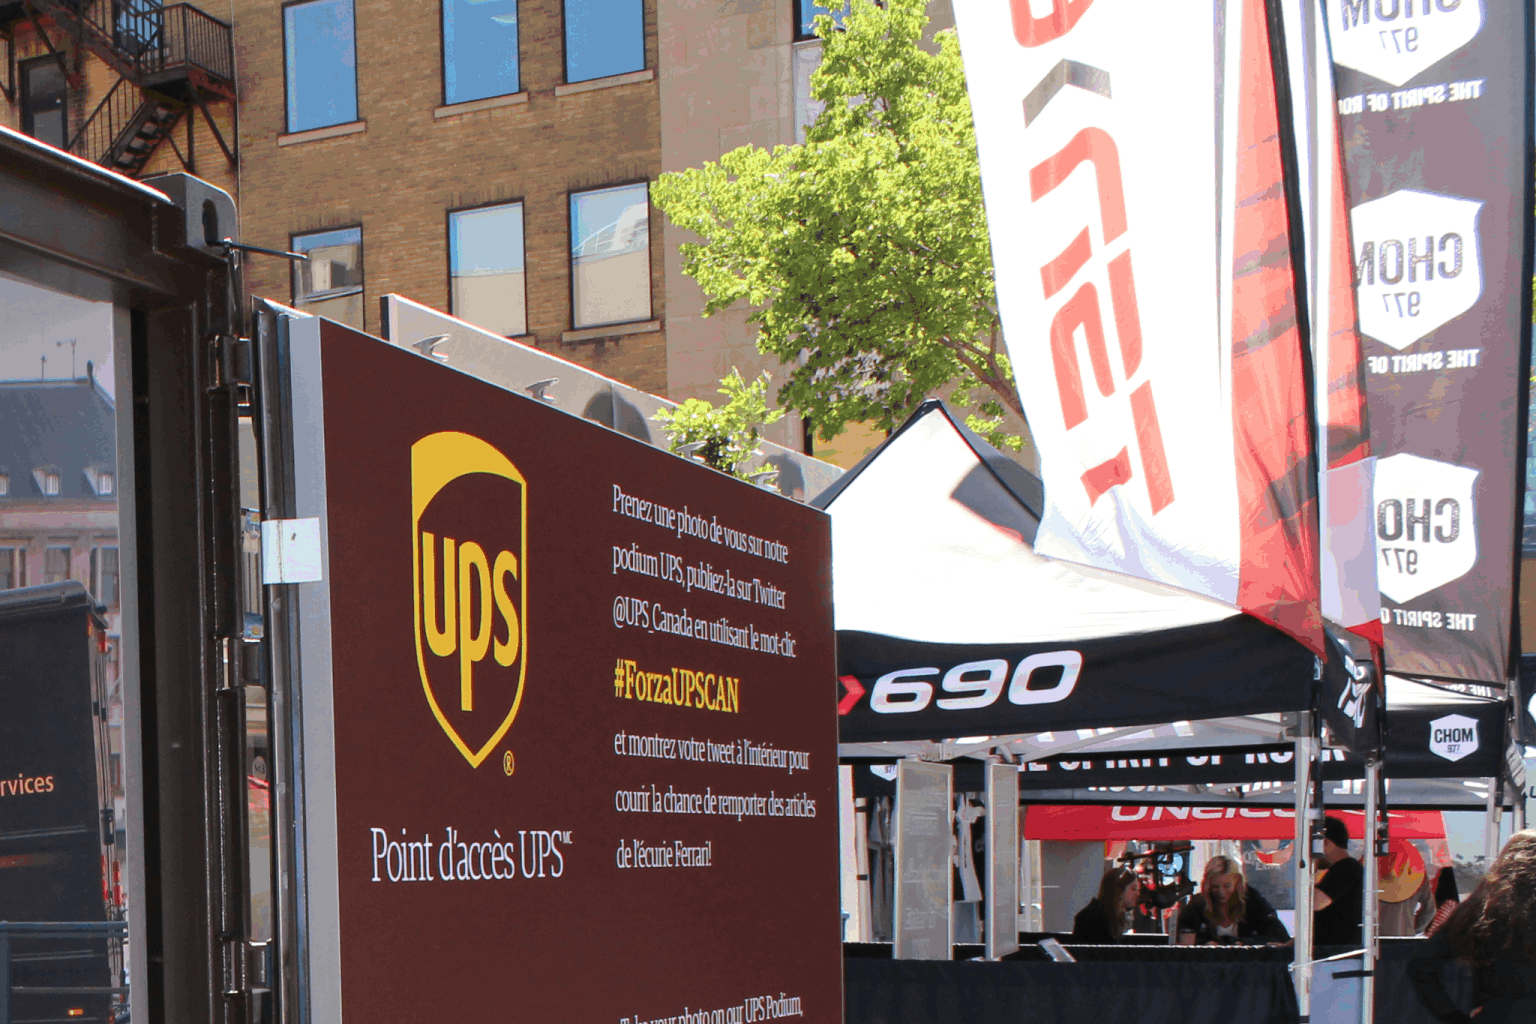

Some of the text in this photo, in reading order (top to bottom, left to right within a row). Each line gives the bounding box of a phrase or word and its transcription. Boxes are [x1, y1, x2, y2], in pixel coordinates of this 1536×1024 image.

[612, 484, 789, 565] Prenez une photo de vous sur notre
[612, 542, 787, 610] podium UPS, publiez-la sur Twitter
[422, 531, 520, 712] ups
[613, 595, 797, 658] @UPS_Canada en utilisant le mot-clic
[614, 658, 741, 714] #ForzaUPSCAN
[870, 650, 1083, 714] 690
[614, 729, 810, 775] et montrez votre tweet à l'intérieur pour
[1434, 728, 1474, 744] CHOM
[615, 783, 817, 822] courir la chance de remporter des articles
[370, 827, 434, 883] Point
[438, 826, 515, 882] d'accès
[616, 838, 712, 869] de l'écurie Ferrari!
[744, 995, 765, 1023] UPS
[765, 992, 804, 1021] Podium,
